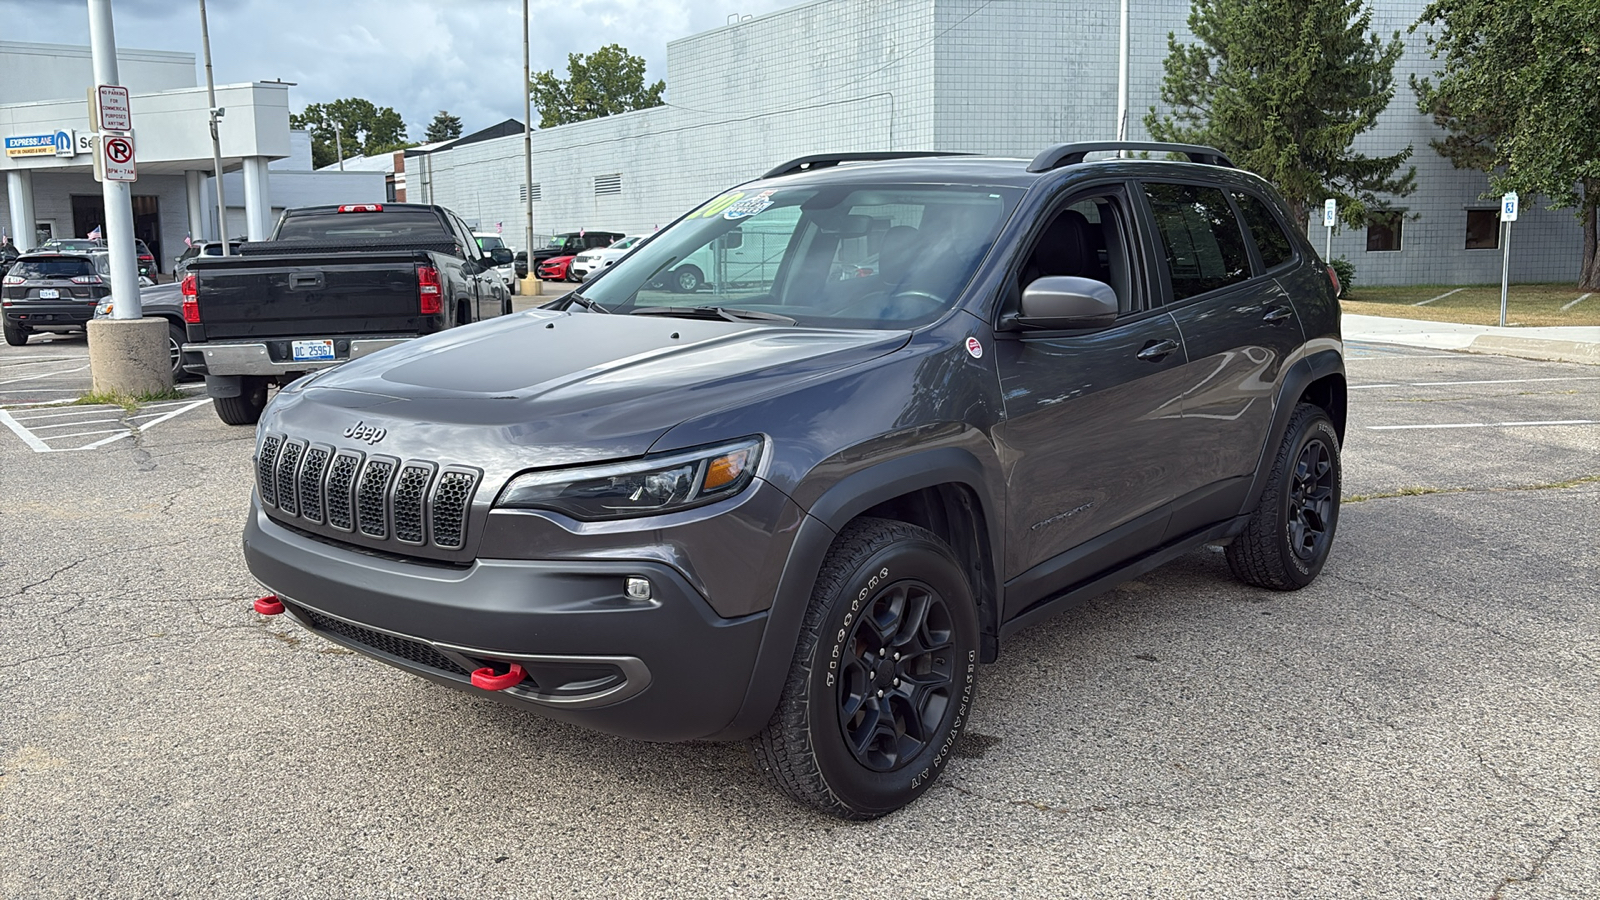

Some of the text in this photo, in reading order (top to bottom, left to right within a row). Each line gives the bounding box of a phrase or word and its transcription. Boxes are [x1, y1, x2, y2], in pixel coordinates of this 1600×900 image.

[294, 345, 332, 357] DC 25967
[343, 420, 388, 446] Jeep
[911, 650, 976, 790] DESTINATION A/T
